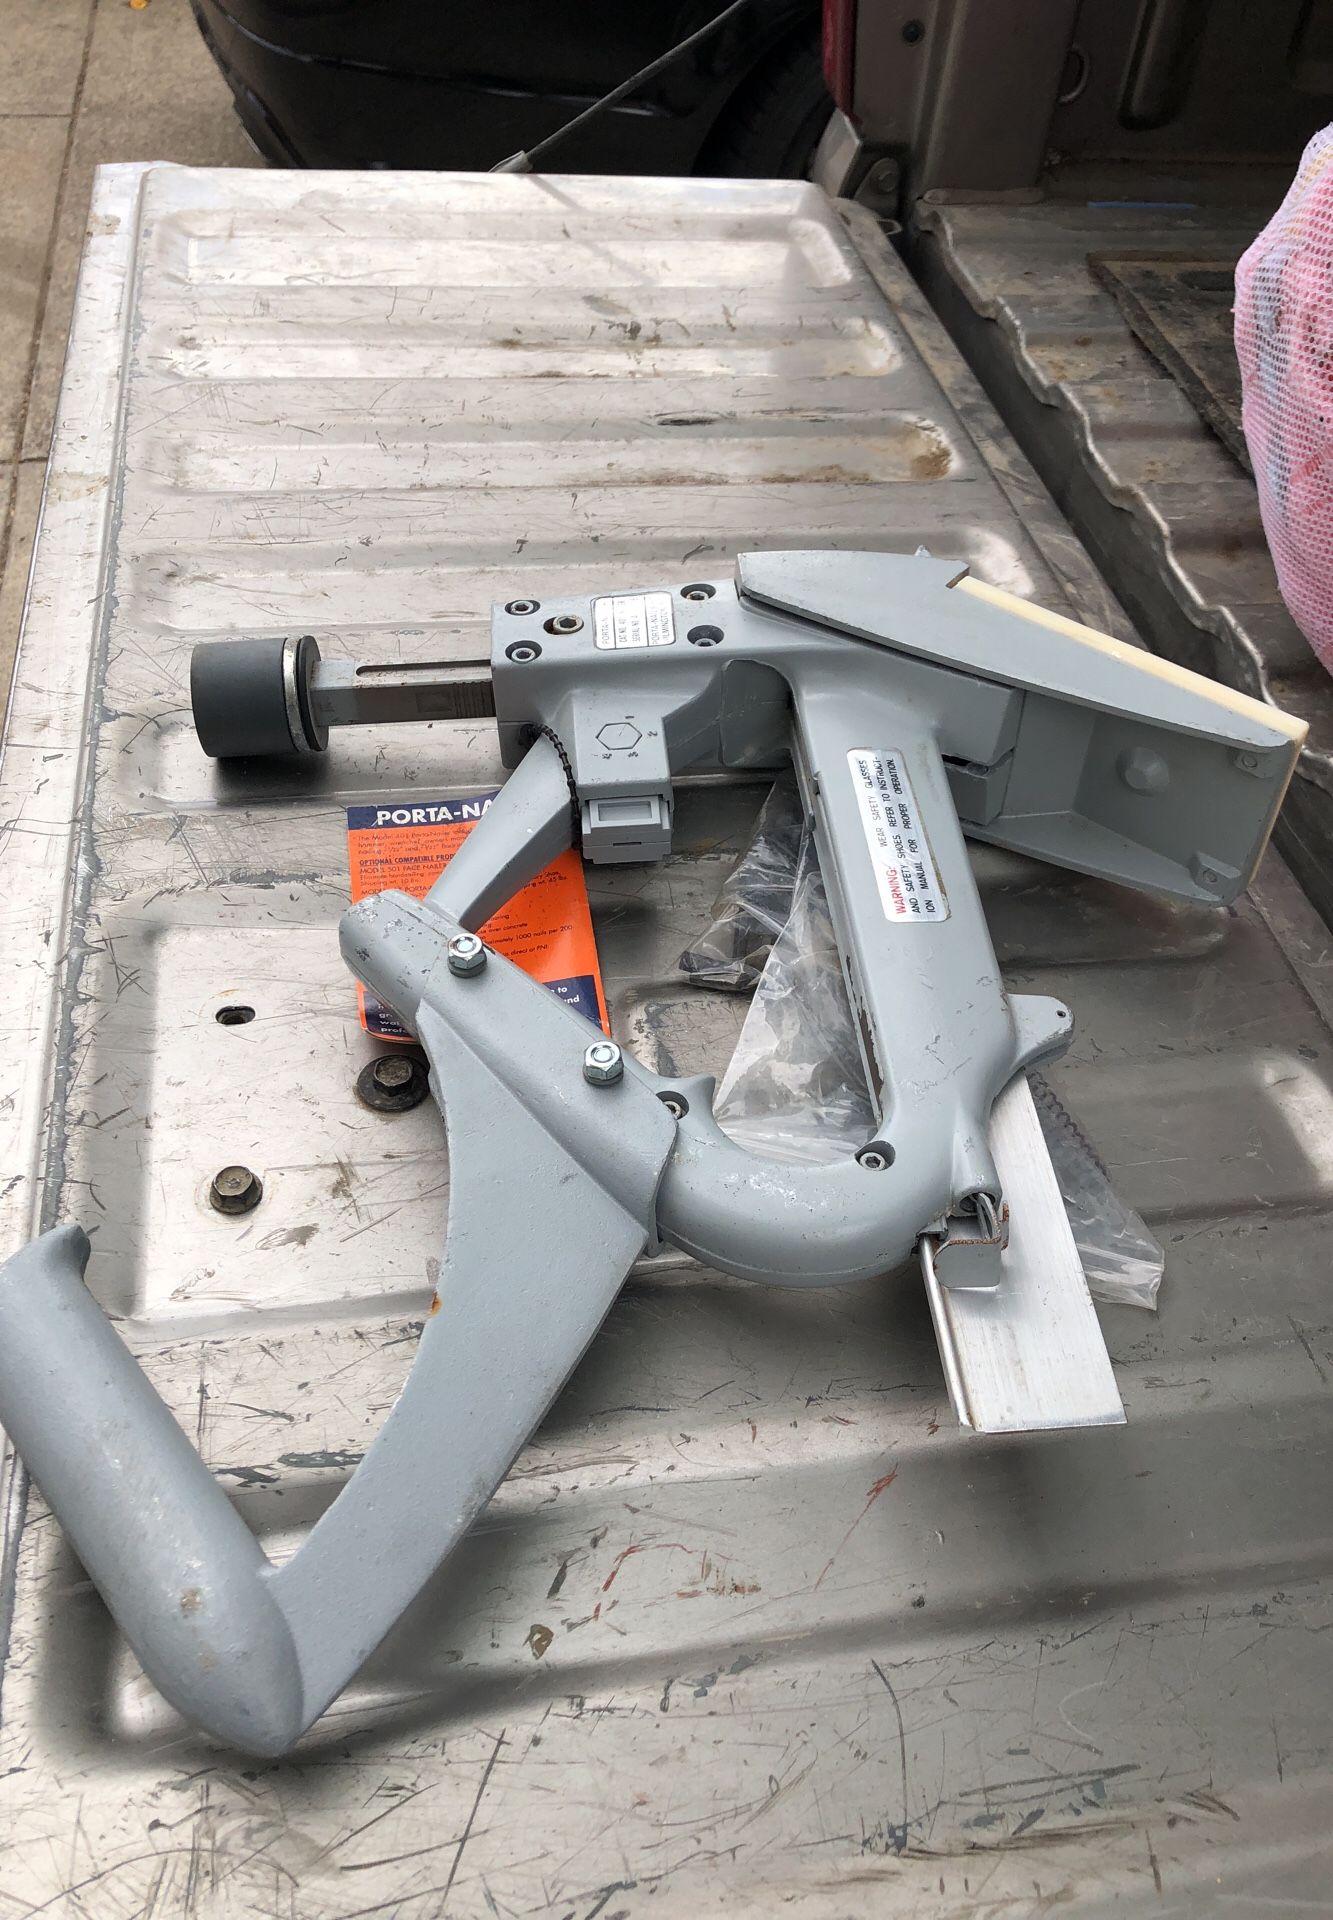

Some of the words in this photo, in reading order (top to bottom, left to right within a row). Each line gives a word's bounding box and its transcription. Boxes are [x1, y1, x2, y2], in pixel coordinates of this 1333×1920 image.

[859, 760, 872, 789] GLASSES
[874, 757, 887, 791] INSTRUCT-
[869, 795, 881, 821] SAFETY
[882, 793, 891, 802] TO
[376, 799, 493, 826] PORTA-NA
[885, 806, 897, 827] REFER
[898, 803, 912, 829] PROPER
[876, 827, 887, 847] WEAR
[908, 838, 919, 853] FOR
[359, 857, 393, 866] OPTIONAL
[394, 855, 434, 864] COMPATIBLE
[436, 853, 456, 861] PROD
[901, 864, 914, 892] SAFETY
[914, 861, 929, 890] MANUAL
[909, 897, 921, 914] AND
[925, 899, 936, 913] ION
[516, 932, 532, 941] 1000
